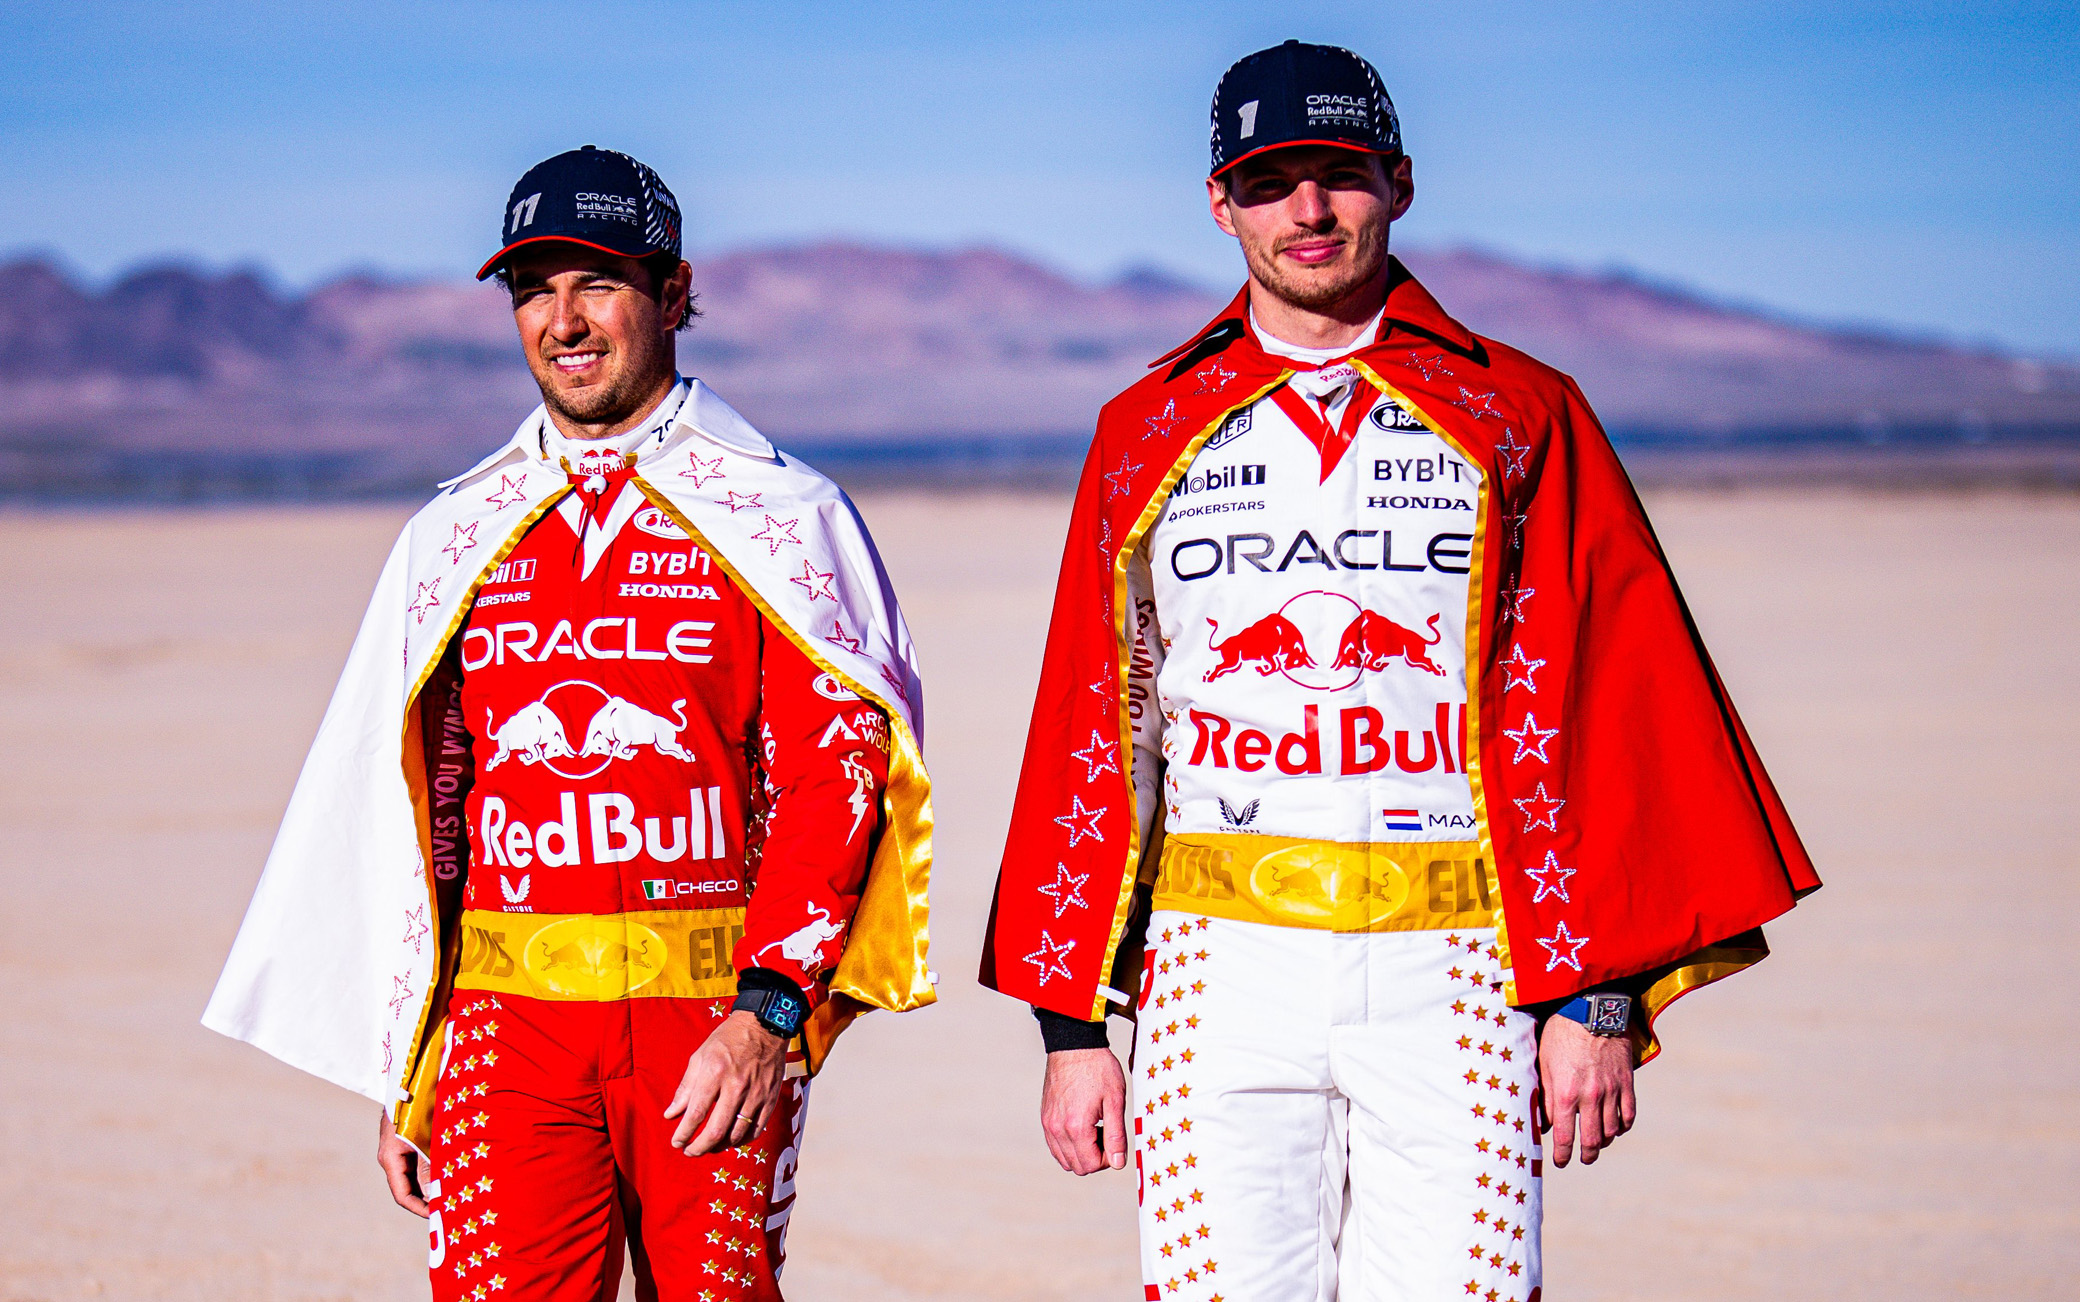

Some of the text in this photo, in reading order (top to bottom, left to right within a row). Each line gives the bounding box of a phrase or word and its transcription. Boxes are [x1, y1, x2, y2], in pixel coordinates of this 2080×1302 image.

[1306, 94, 1367, 107] ORACLE
[1238, 100, 1259, 139] 1
[1307, 106, 1342, 116] Red Bull
[1309, 119, 1369, 129] RACING
[575, 192, 637, 206] ORACLE
[576, 202, 611, 211] Red Bull
[511, 193, 542, 235] 11
[577, 213, 638, 226] RACING
[580, 462, 601, 475] Red
[1374, 453, 1464, 483] BYBIT
[1179, 500, 1265, 519] POKERSTARS
[1367, 496, 1475, 512] HONDA
[628, 547, 711, 576] BYBIT
[1171, 529, 1475, 582] ORACLE
[475, 592, 531, 608] KERSTARS
[618, 584, 721, 601] HONDA
[462, 617, 716, 672] ORACLE
[1188, 704, 1323, 776] Red
[1340, 702, 1467, 777] Bull
[434, 763, 463, 808] YOU
[480, 791, 581, 868] Red
[588, 786, 726, 865] Bull
[1428, 813, 1477, 829] MAX
[433, 815, 460, 880] GIVES
[677, 879, 739, 895] CHECO
